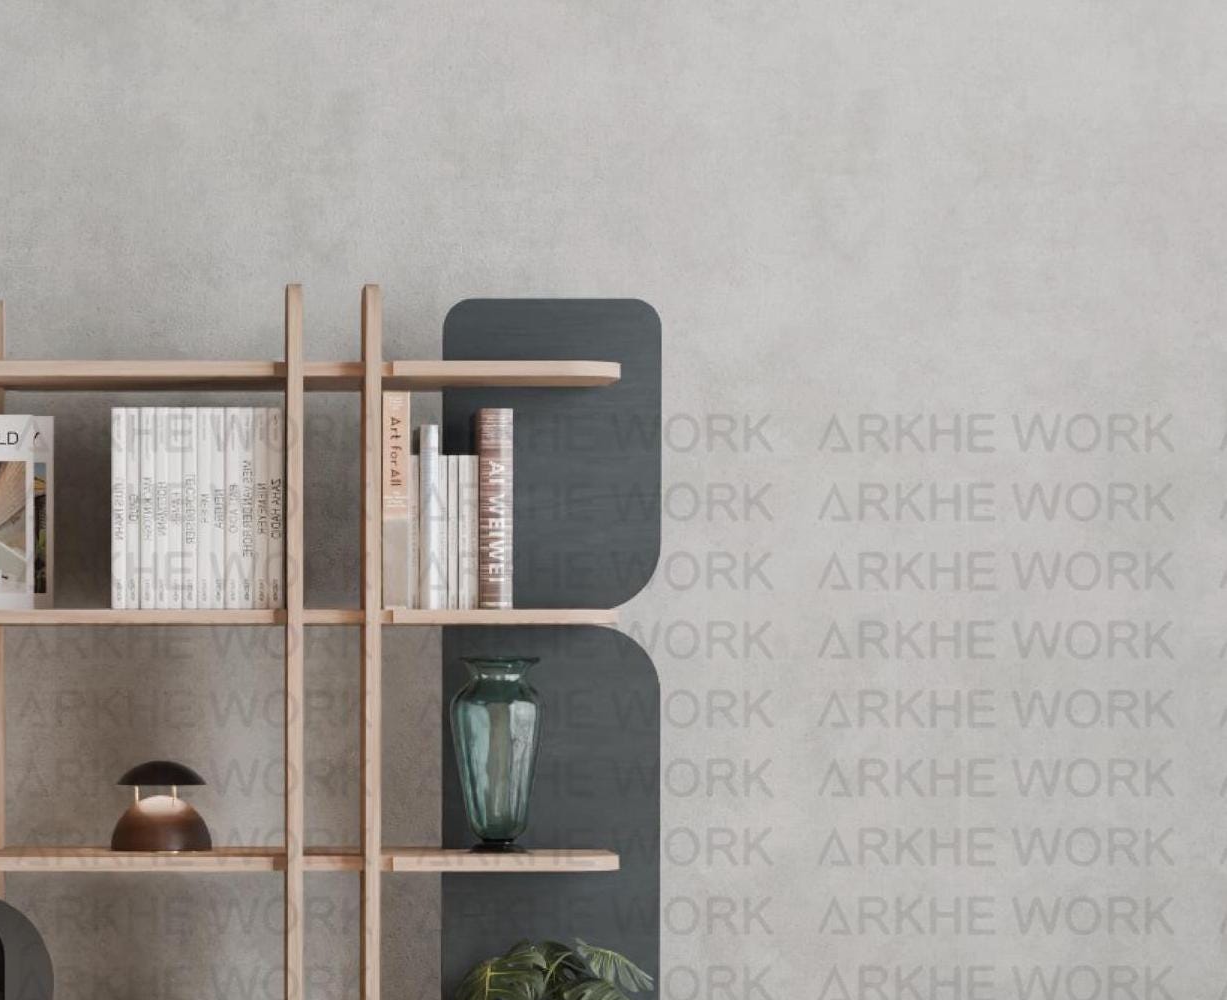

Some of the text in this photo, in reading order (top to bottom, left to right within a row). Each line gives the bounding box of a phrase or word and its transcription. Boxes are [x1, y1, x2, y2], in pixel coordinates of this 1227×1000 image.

[389, 416, 402, 440] Art
[389, 444, 402, 465] for
[389, 468, 402, 487] All
